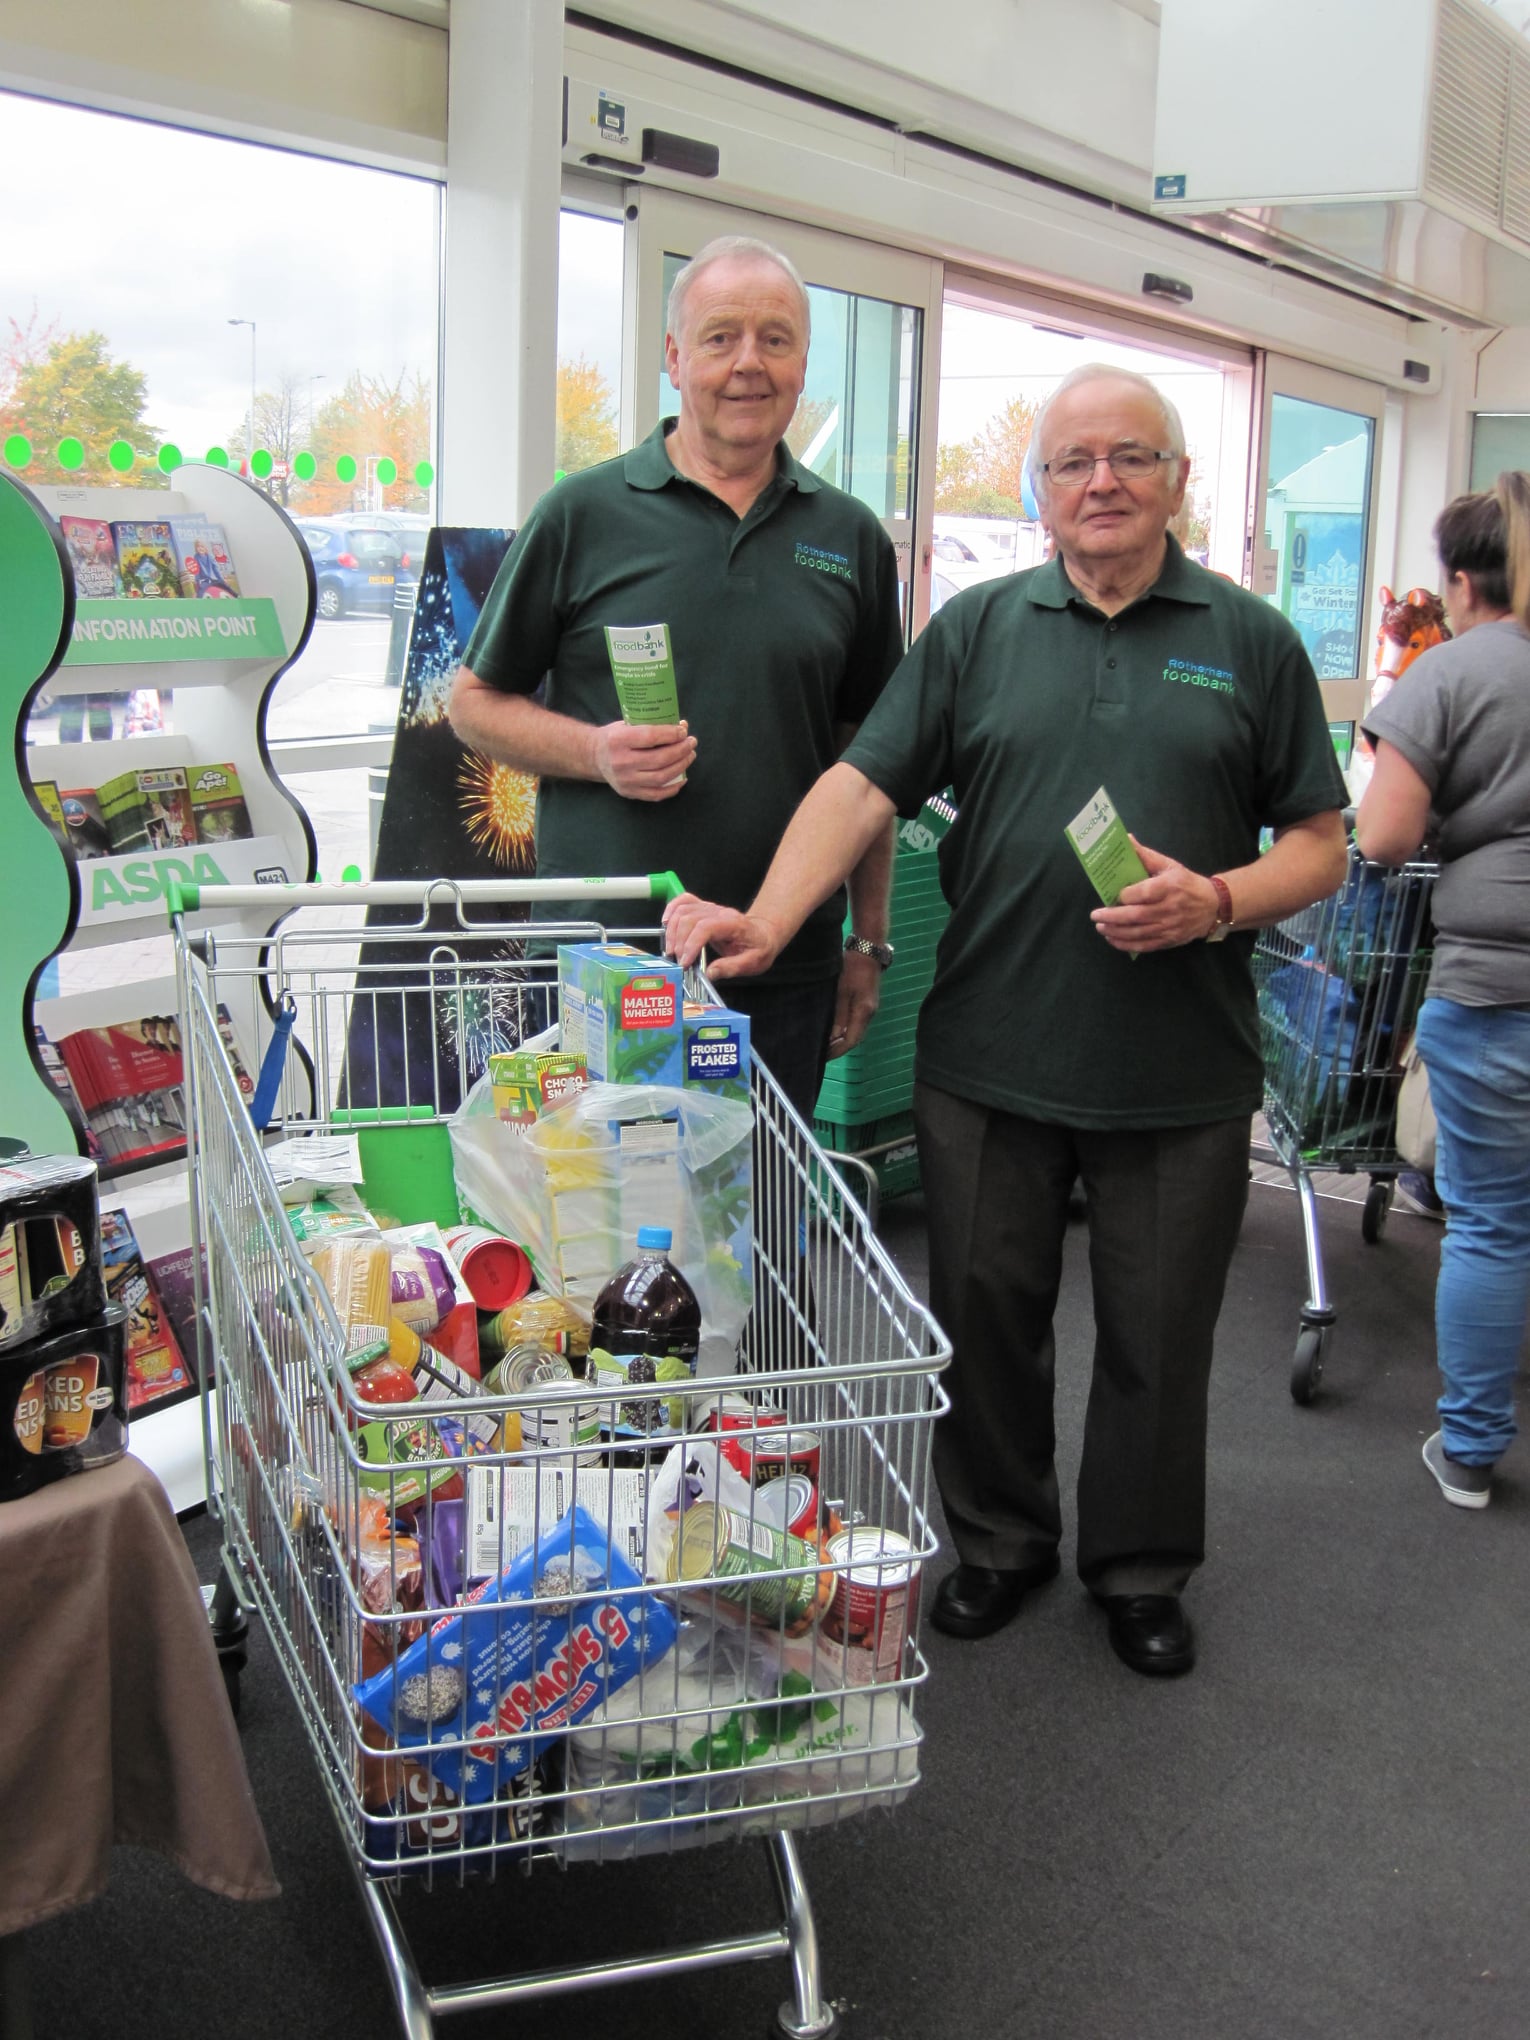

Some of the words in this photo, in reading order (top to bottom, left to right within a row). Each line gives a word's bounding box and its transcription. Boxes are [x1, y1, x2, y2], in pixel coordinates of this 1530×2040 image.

[795, 553, 851, 579] foodbank
[74, 617, 200, 642] INFORMATION
[203, 616, 257, 637] POINT
[614, 640, 665, 651] foodbank
[1168, 659, 1233, 680] Rotherham
[1162, 668, 1236, 696] foodbank
[194, 776, 228, 793] Ape!
[203, 770, 222, 781] Go
[92, 852, 231, 911] ASDA
[624, 996, 673, 1008] MALTED
[624, 1007, 673, 1018] WHEATIES
[690, 1043, 737, 1054] FROSTED
[690, 1053, 738, 1067] FLAKES
[44, 1376, 84, 1394] KED
[44, 1395, 83, 1412] ANS
[756, 1463, 809, 1481] HEINZ
[476, 1524, 484, 1535] 85g
[504, 1618, 541, 1649] oating,
[599, 1605, 631, 1649] 5
[475, 1629, 514, 1660] coonut
[509, 1618, 555, 1657] choolate
[469, 1645, 509, 1678] cvered
[470, 1652, 515, 1688] flaoured
